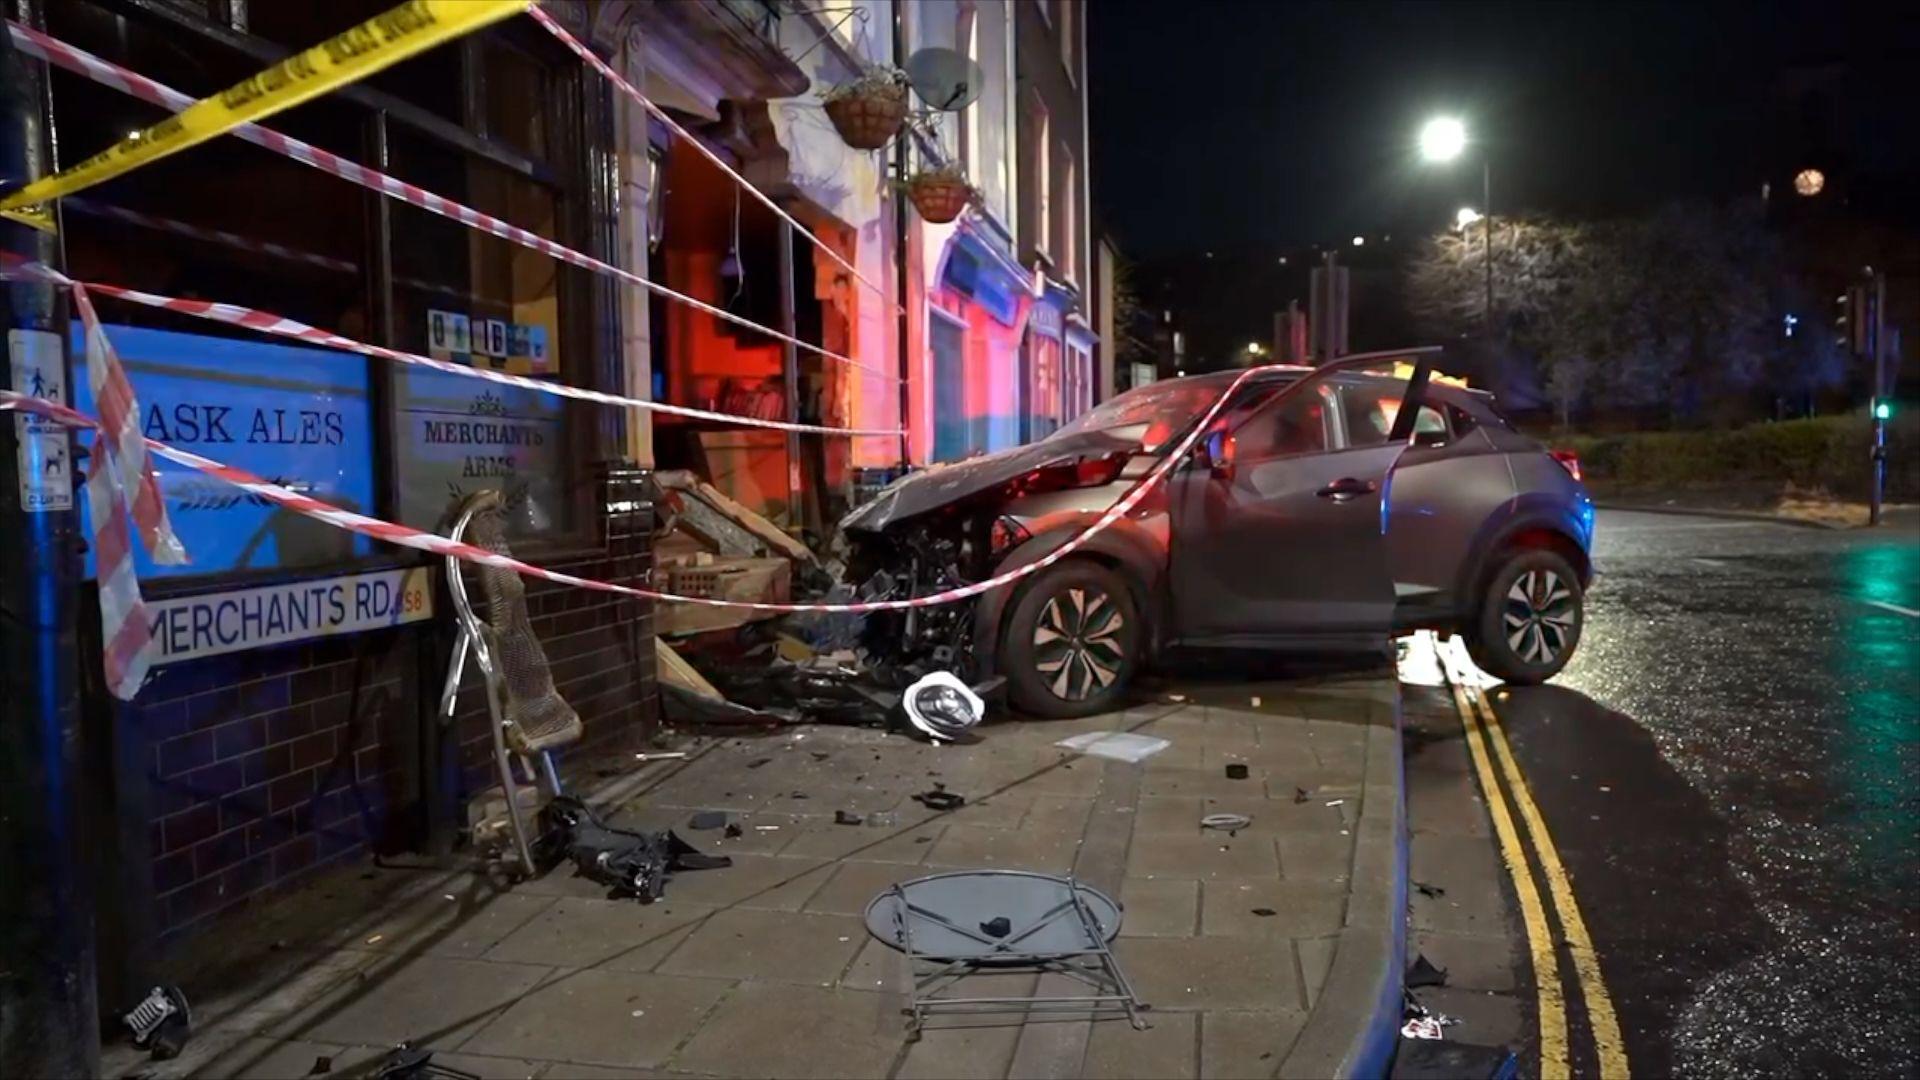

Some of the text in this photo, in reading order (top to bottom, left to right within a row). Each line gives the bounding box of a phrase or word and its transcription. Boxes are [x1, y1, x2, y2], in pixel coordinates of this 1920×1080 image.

[144, 404, 345, 446] ASK ALES
[424, 420, 544, 447] MERCHANTS
[462, 455, 517, 478] ARMS
[149, 584, 346, 656] MERCHANTS
